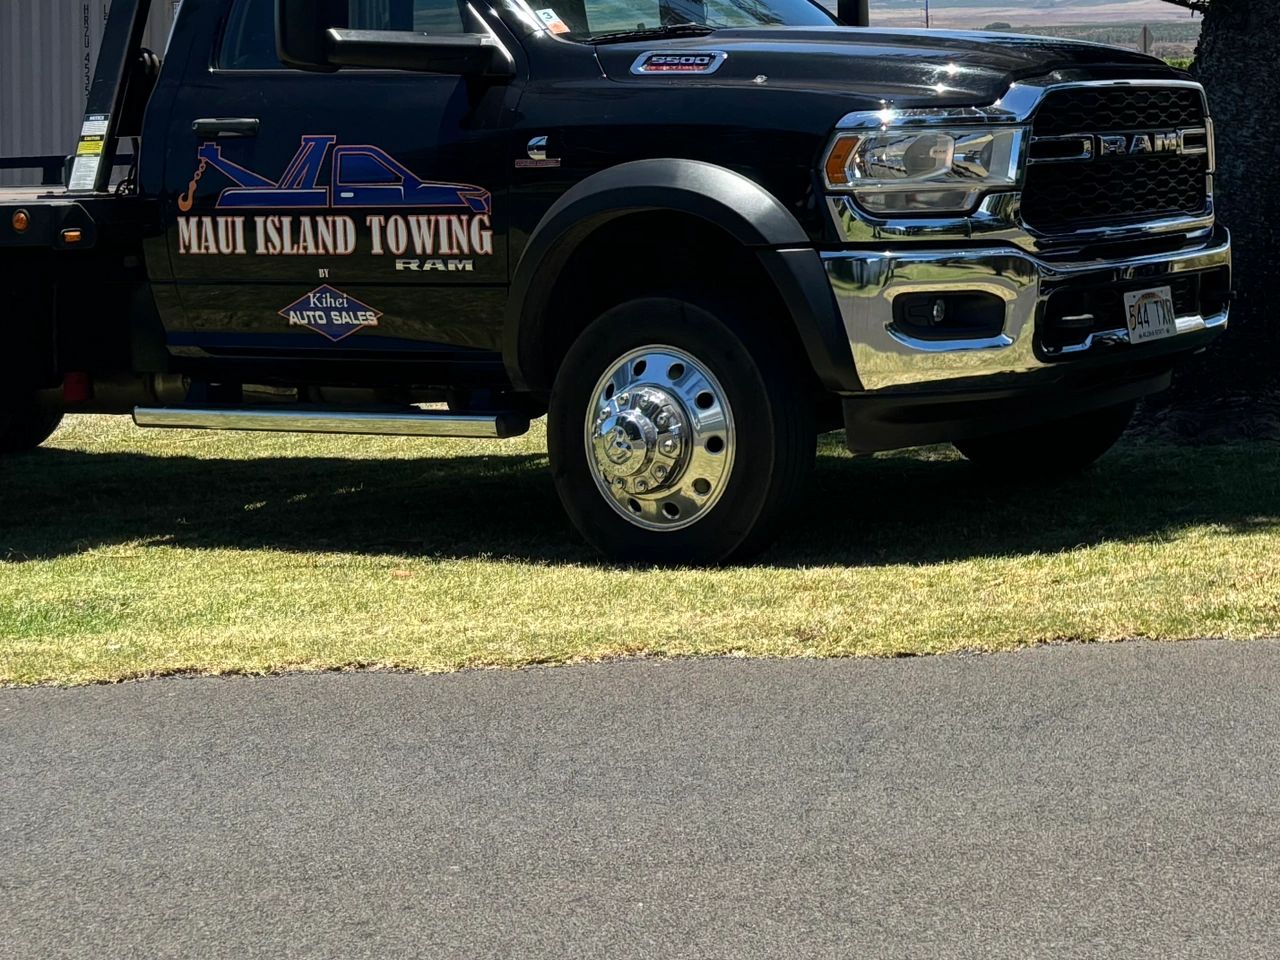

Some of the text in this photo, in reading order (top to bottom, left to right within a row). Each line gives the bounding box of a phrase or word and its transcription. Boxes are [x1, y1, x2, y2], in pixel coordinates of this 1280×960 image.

[651, 56, 711, 64] 5500
[1099, 133, 1181, 155] RAM
[177, 214, 494, 256] MAUI ISLAND TOWING
[318, 268, 329, 278] BY
[395, 258, 474, 272] RAM
[308, 292, 349, 308] Kihei
[288, 310, 379, 326] AUTO SALES
[1129, 302, 1150, 331] 544
